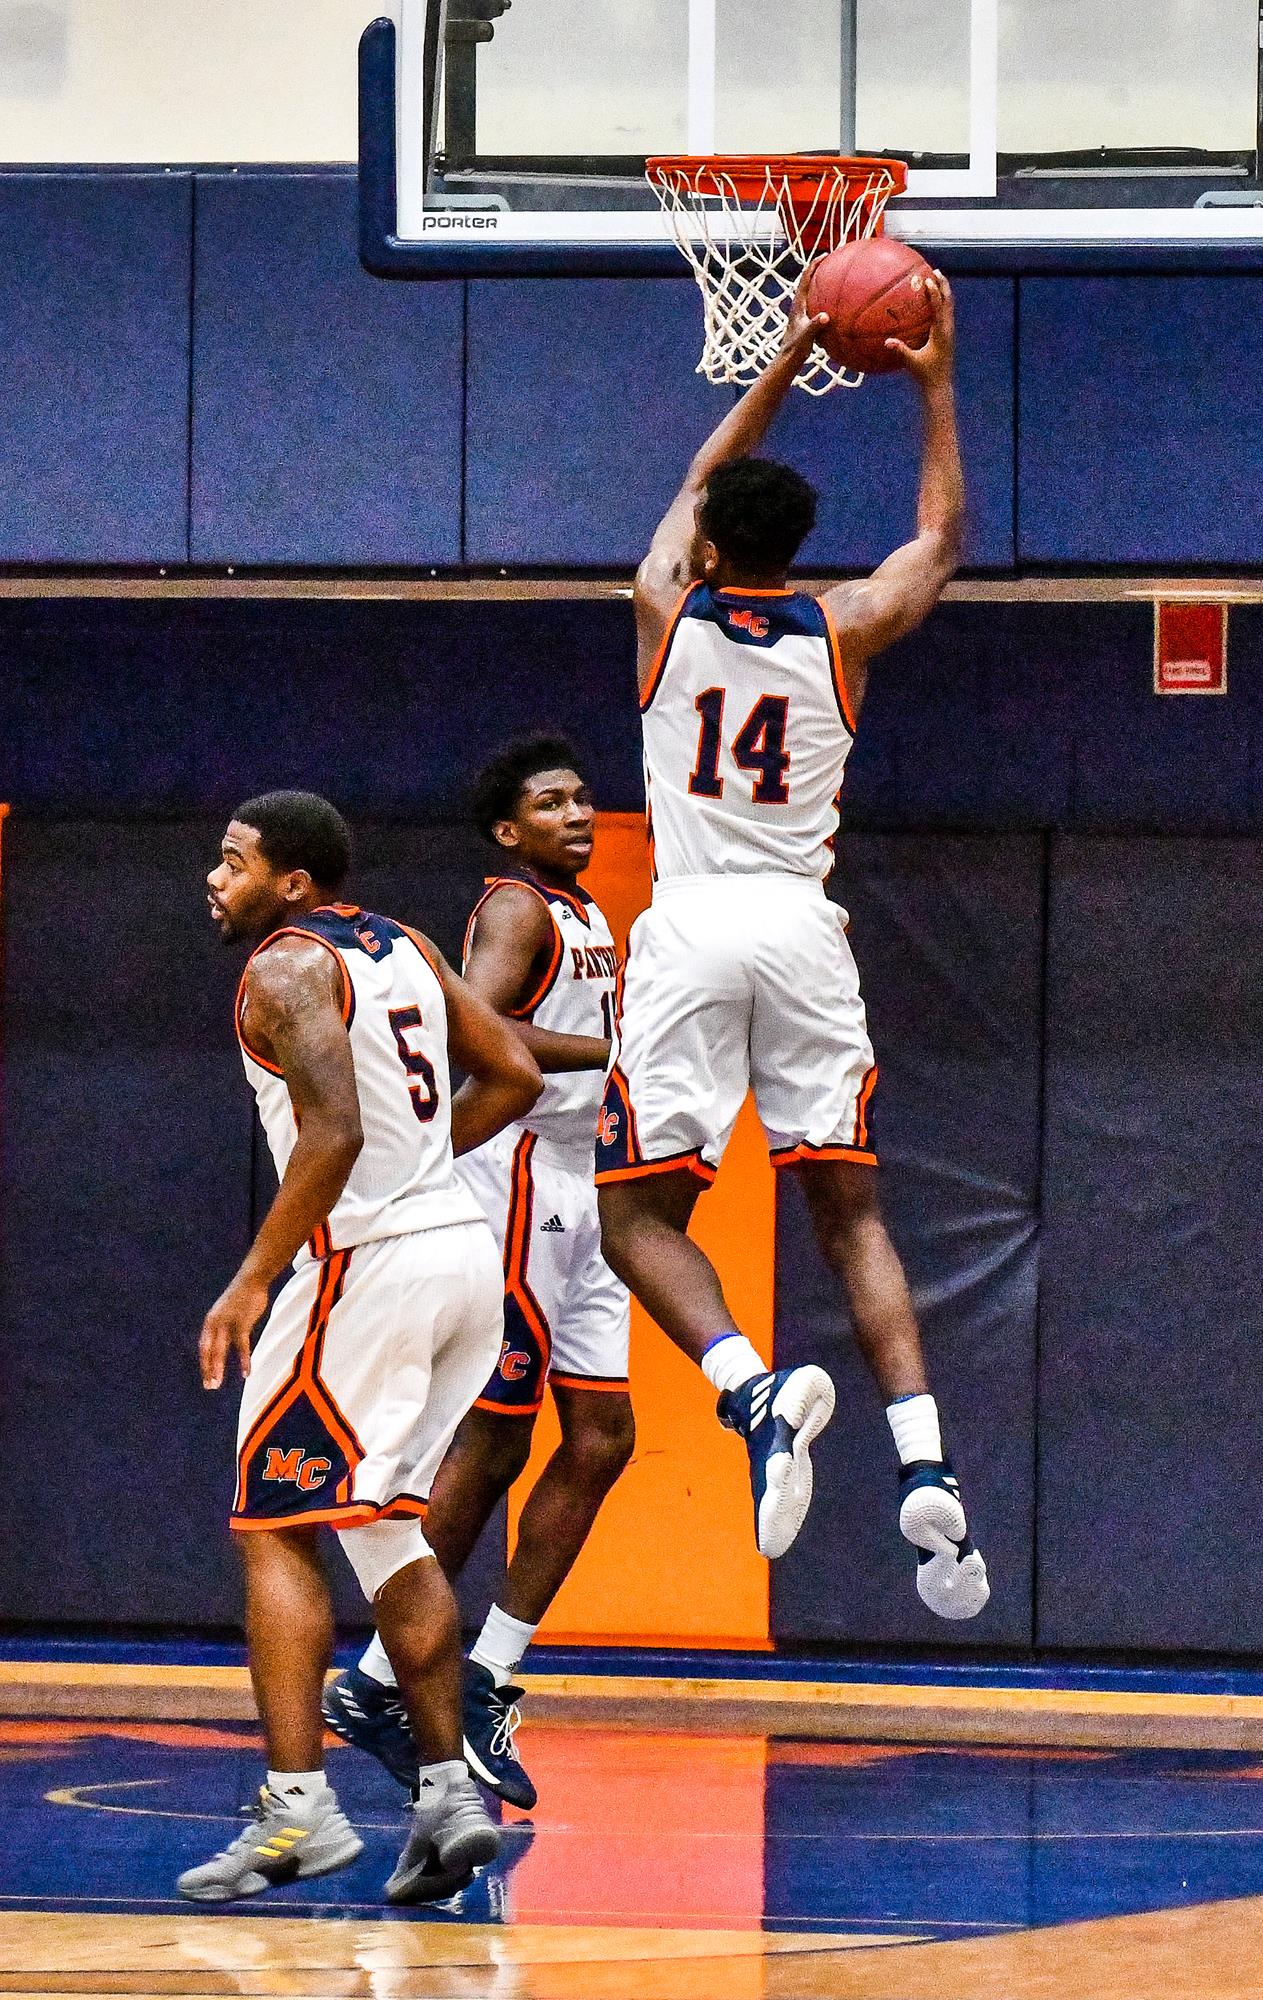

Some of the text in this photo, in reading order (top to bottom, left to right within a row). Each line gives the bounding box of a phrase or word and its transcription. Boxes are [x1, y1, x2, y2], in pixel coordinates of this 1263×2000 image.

[728, 610, 769, 637] MC
[687, 686, 791, 805] 14
[387, 1003, 440, 1124] 5
[497, 1340, 531, 1381] C
[262, 1447, 332, 1492] MC
